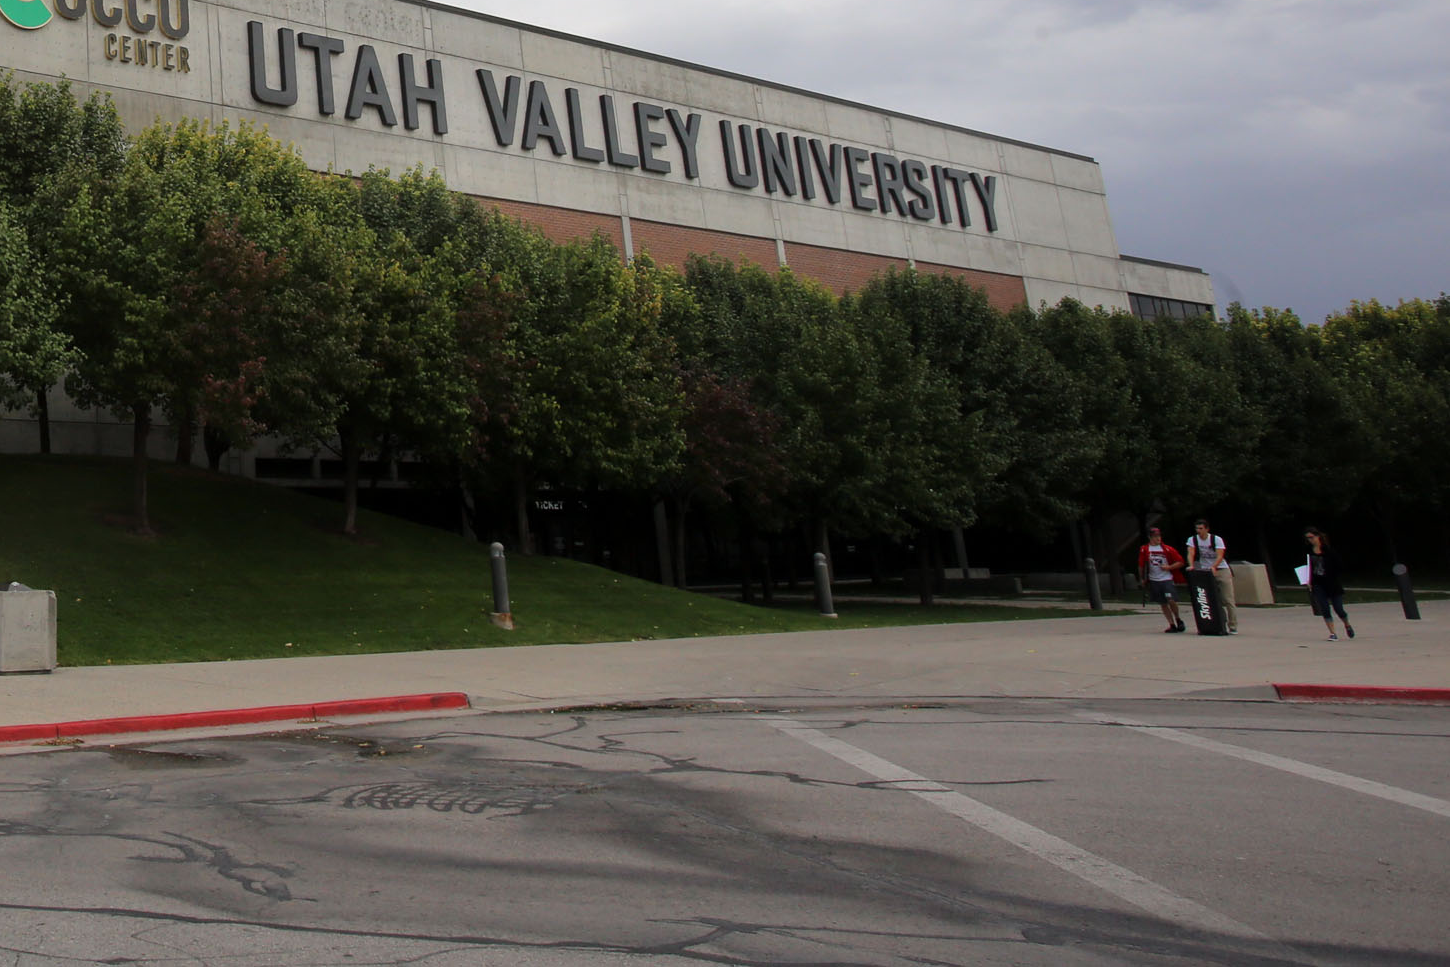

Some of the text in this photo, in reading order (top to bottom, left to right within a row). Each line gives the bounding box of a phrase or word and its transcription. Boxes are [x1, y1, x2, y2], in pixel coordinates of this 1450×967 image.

[104, 32, 191, 74] CENTER
[246, 20, 999, 232] UTAH VALLEY UNIVERSITY
[1197, 587, 1211, 620] Skyline
